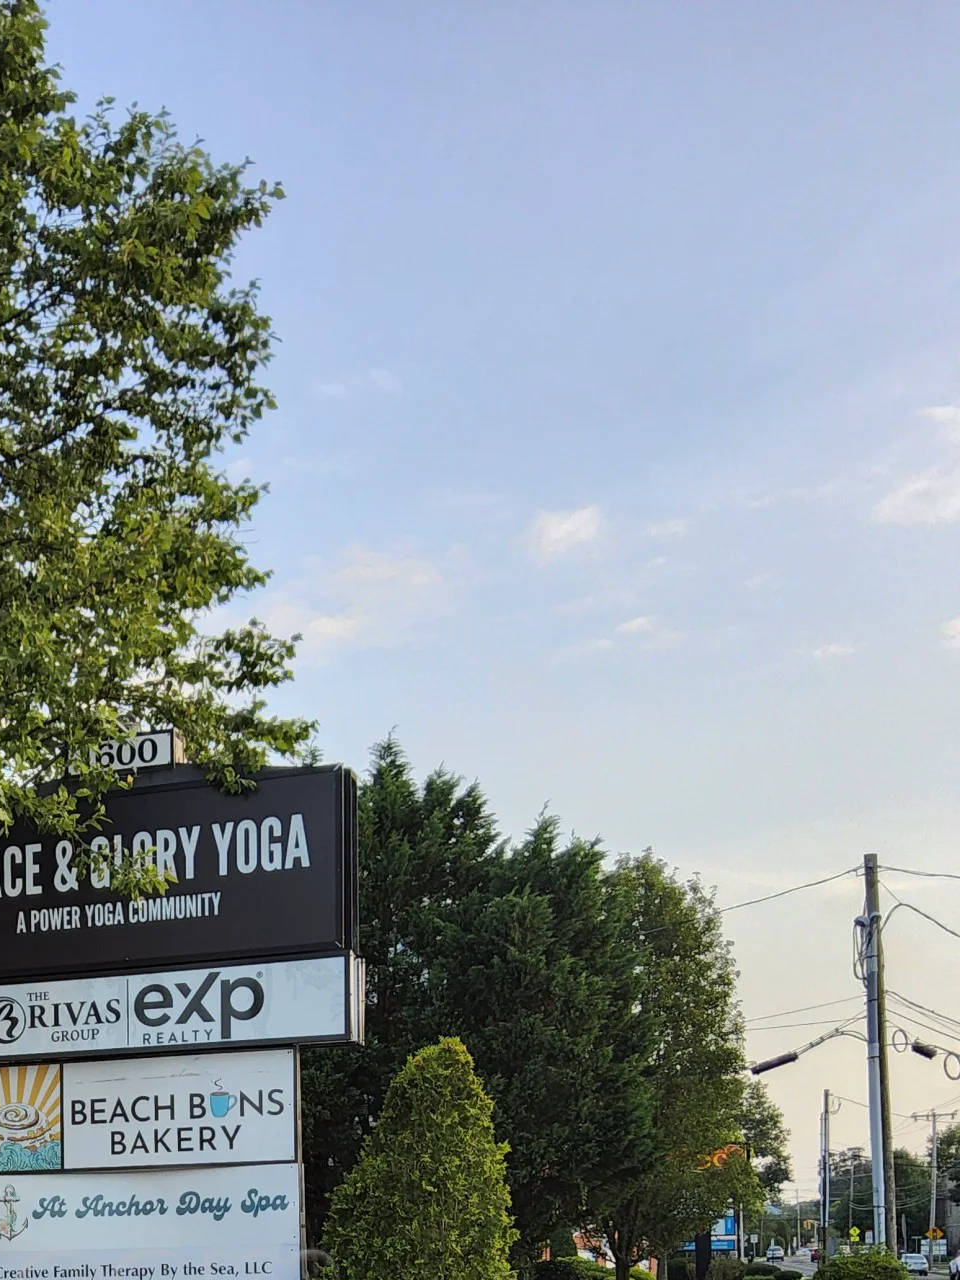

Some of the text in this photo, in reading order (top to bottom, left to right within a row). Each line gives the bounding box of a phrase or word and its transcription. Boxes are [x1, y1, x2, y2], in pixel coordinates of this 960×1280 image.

[53, 839, 78, 892] &
[211, 813, 311, 876] YOGA
[16, 891, 222, 934] A POWER YOGA COMMUNITY
[27, 991, 50, 1002] THE
[27, 998, 121, 1029] RIVAS
[51, 1028, 100, 1043] GROUP
[142, 1028, 213, 1045] REALTY
[71, 1094, 175, 1125] BEACH
[111, 1125, 242, 1155] BAKERY
[32, 1188, 289, 1221] At Anchor Day Spa
[53, 1264, 97, 1280] Family
[100, 1263, 155, 1280] Therapy
[160, 1263, 178, 1280] By
[183, 1261, 205, 1275] the
[210, 1262, 240, 1278] Sea,
[245, 1261, 273, 1275] LLC
